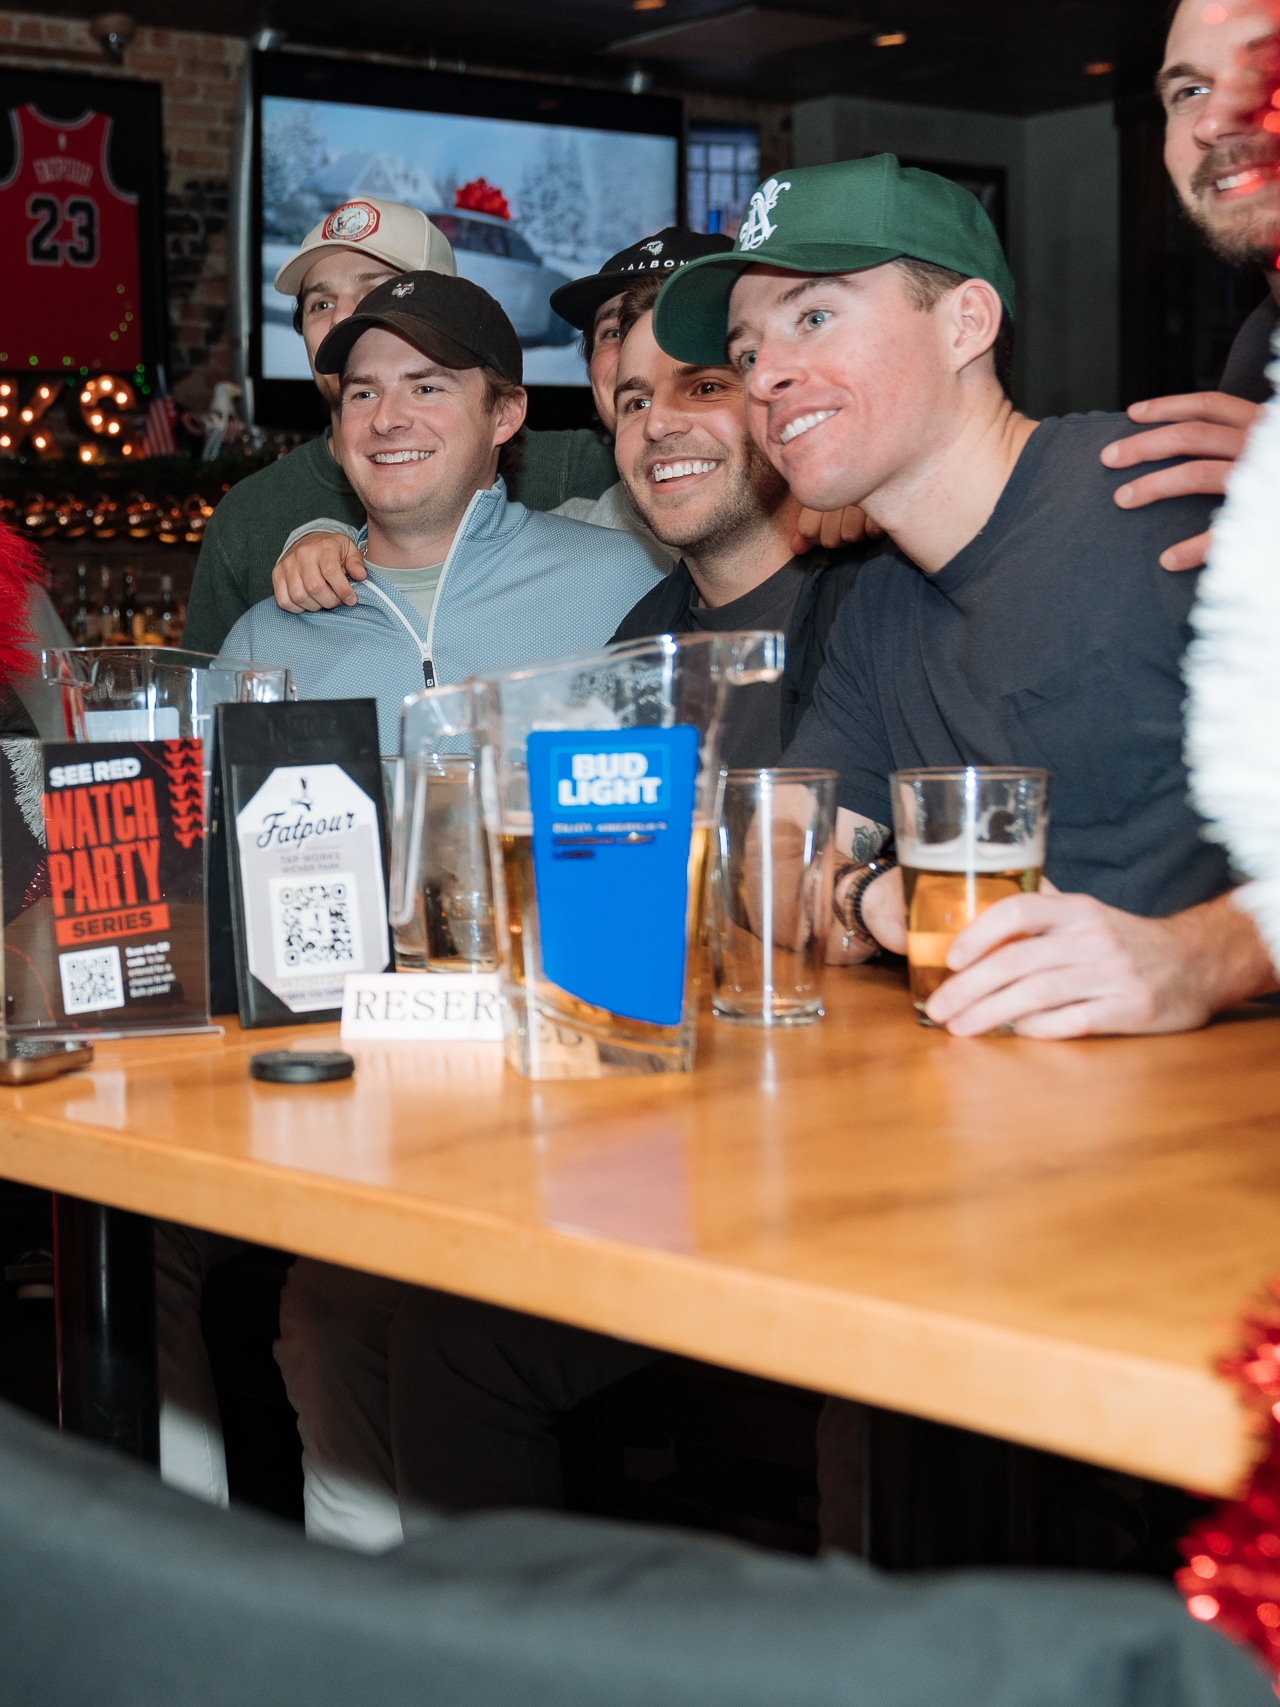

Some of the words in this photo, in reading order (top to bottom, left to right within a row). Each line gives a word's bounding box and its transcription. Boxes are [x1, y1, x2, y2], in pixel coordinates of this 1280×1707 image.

[26, 192, 101, 267] 23
[620, 259, 690, 272] ALBON
[49, 762, 93, 788] SEE
[93, 756, 141, 783] RED
[572, 752, 649, 780] BUD
[558, 777, 663, 806] LIGHT
[43, 778, 159, 852] WATCH
[257, 811, 355, 848] Fatpour
[48, 840, 160, 917] PARTY
[73, 910, 153, 938] SERIES
